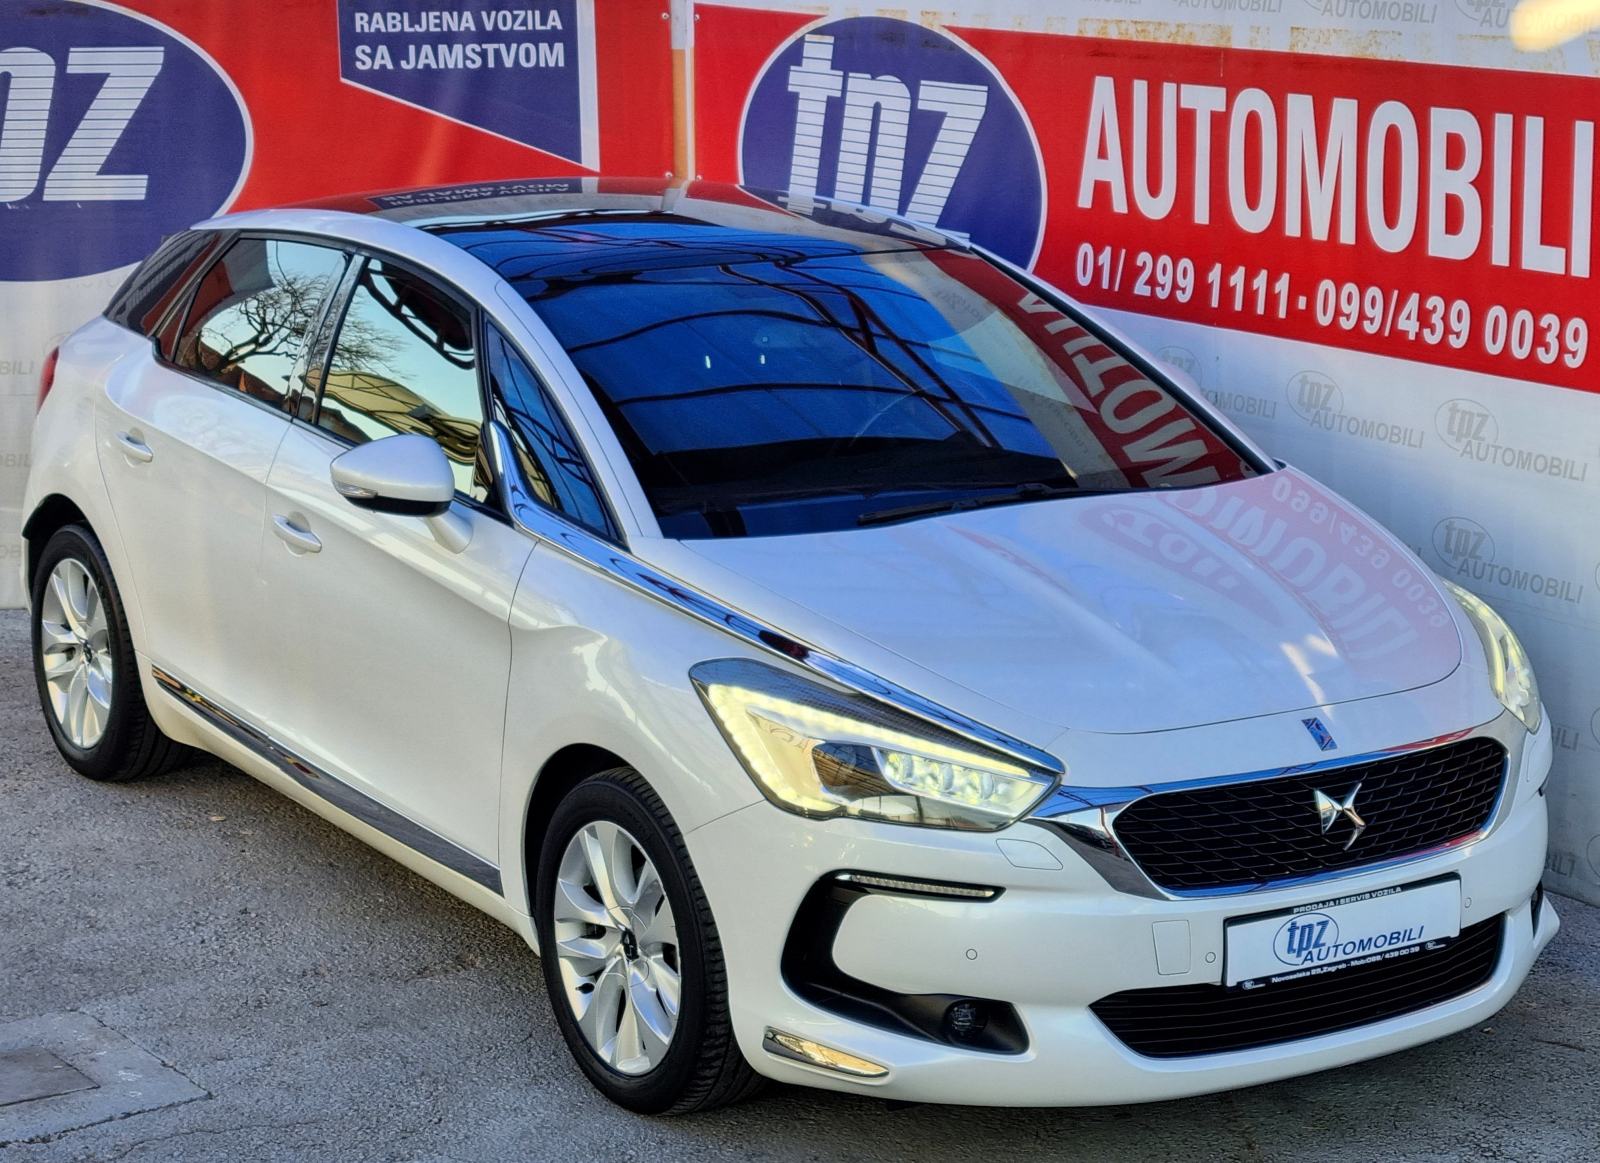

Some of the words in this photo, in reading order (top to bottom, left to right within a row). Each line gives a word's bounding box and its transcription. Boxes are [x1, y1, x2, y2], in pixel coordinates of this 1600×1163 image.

[354, 11, 476, 33] RABLJENA
[480, 9, 563, 31] VOZILA
[1321, 0, 1437, 25] AUTOMOBILI
[355, 45, 394, 70] SA
[400, 42, 565, 70] JAMSTVOM
[1076, 75, 1595, 279] AUTOMOBILI
[1133, 251, 1195, 303] 299
[1484, 305, 1589, 369] 0039
[1199, 388, 1277, 420] OMOBILI
[1297, 374, 1336, 413] tpz
[1309, 409, 1425, 449] AUTOMOBILI
[1447, 402, 1489, 443] tpz
[1459, 440, 1588, 482] AUTOMOBILI
[1445, 520, 1486, 561] tpz
[1456, 558, 1584, 604] AUTOMOBILI
[1287, 919, 1330, 958] tpz
[1301, 926, 1424, 965] AUTOMOBILI
